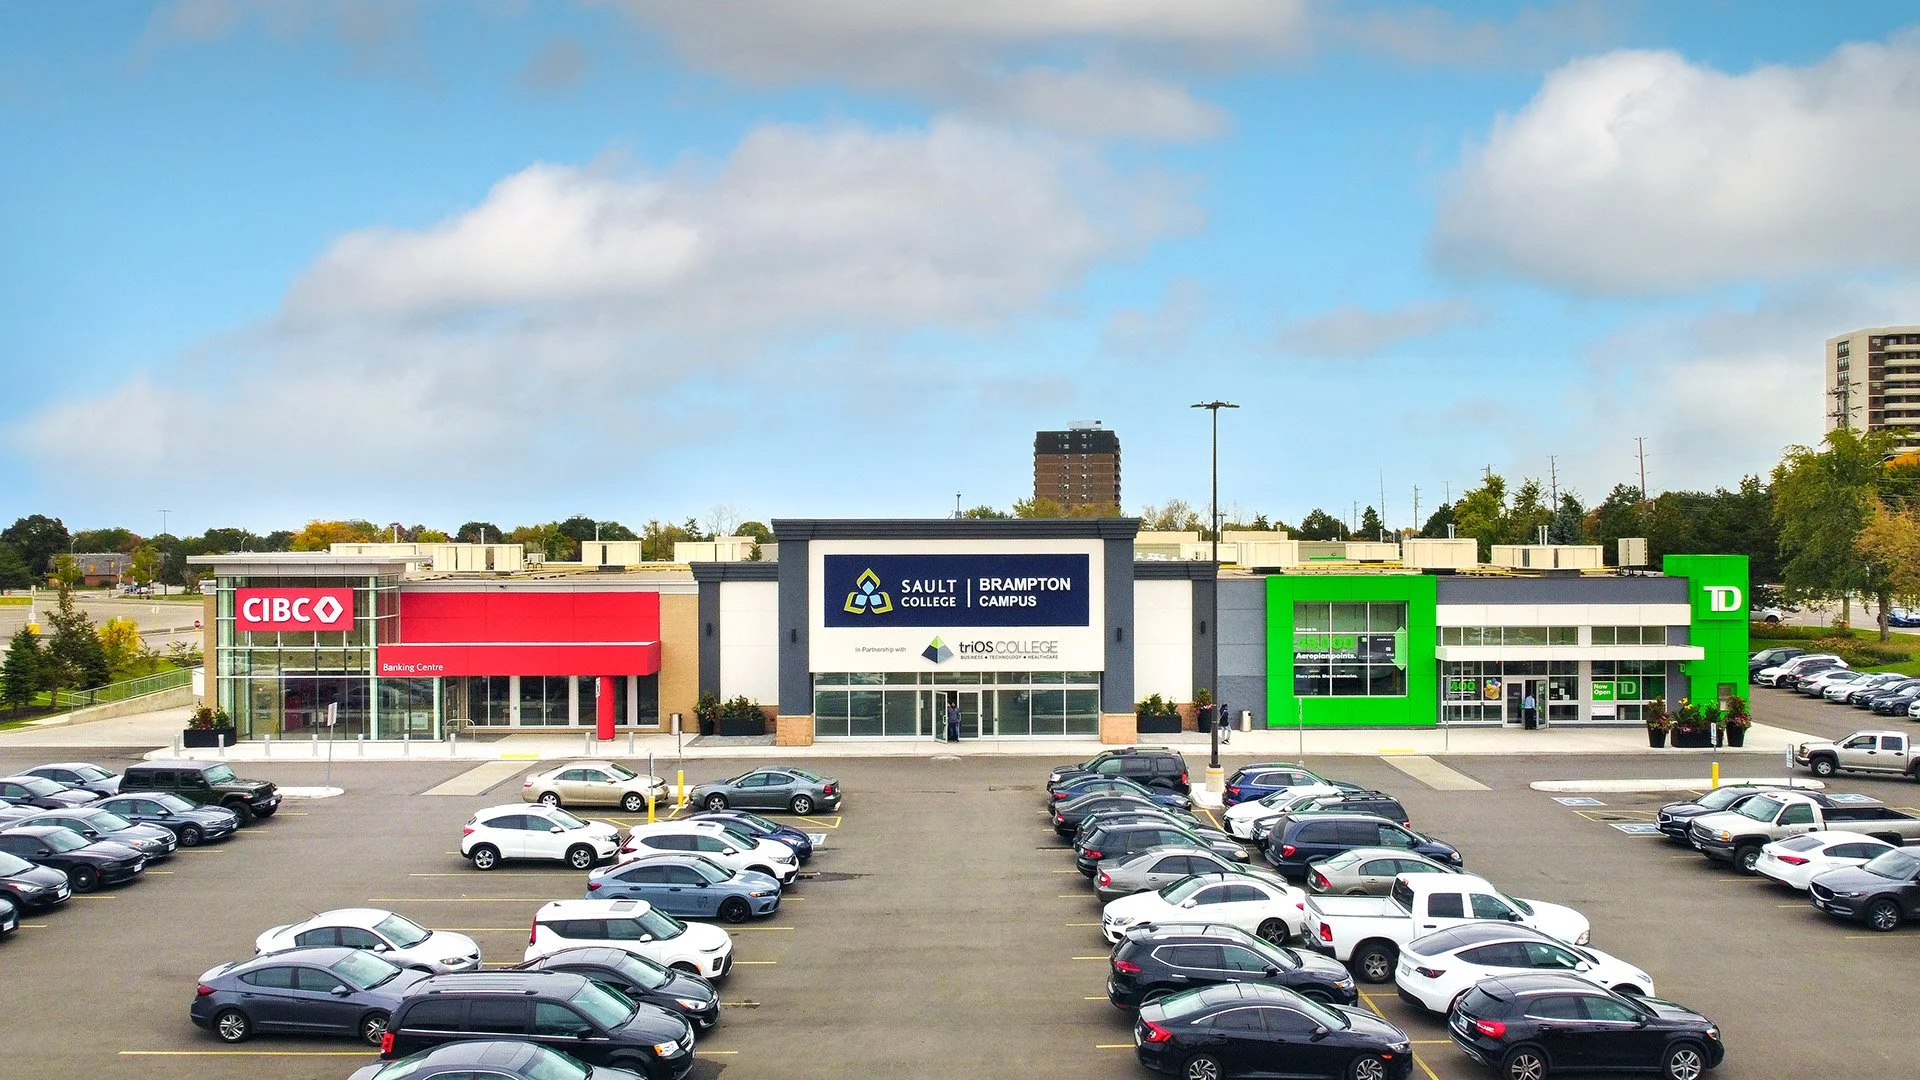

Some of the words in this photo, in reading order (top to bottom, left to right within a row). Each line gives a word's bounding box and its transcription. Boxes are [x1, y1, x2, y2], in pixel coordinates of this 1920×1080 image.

[901, 579, 957, 593] SAULT
[979, 577, 1071, 592] BRAMPTON
[901, 596, 957, 608] COLLEGE
[979, 595, 1037, 608] CAMPUS
[1703, 585, 1742, 612] TD
[242, 597, 311, 623] CIBC
[862, 646, 894, 654] Partnership
[958, 640, 994, 653] triOS
[995, 640, 1059, 654] COLLEGE
[1295, 652, 1331, 660] Aeroplan
[383, 663, 415, 673] Banking
[416, 662, 444, 671] Centre
[1617, 681, 1637, 695] TD
